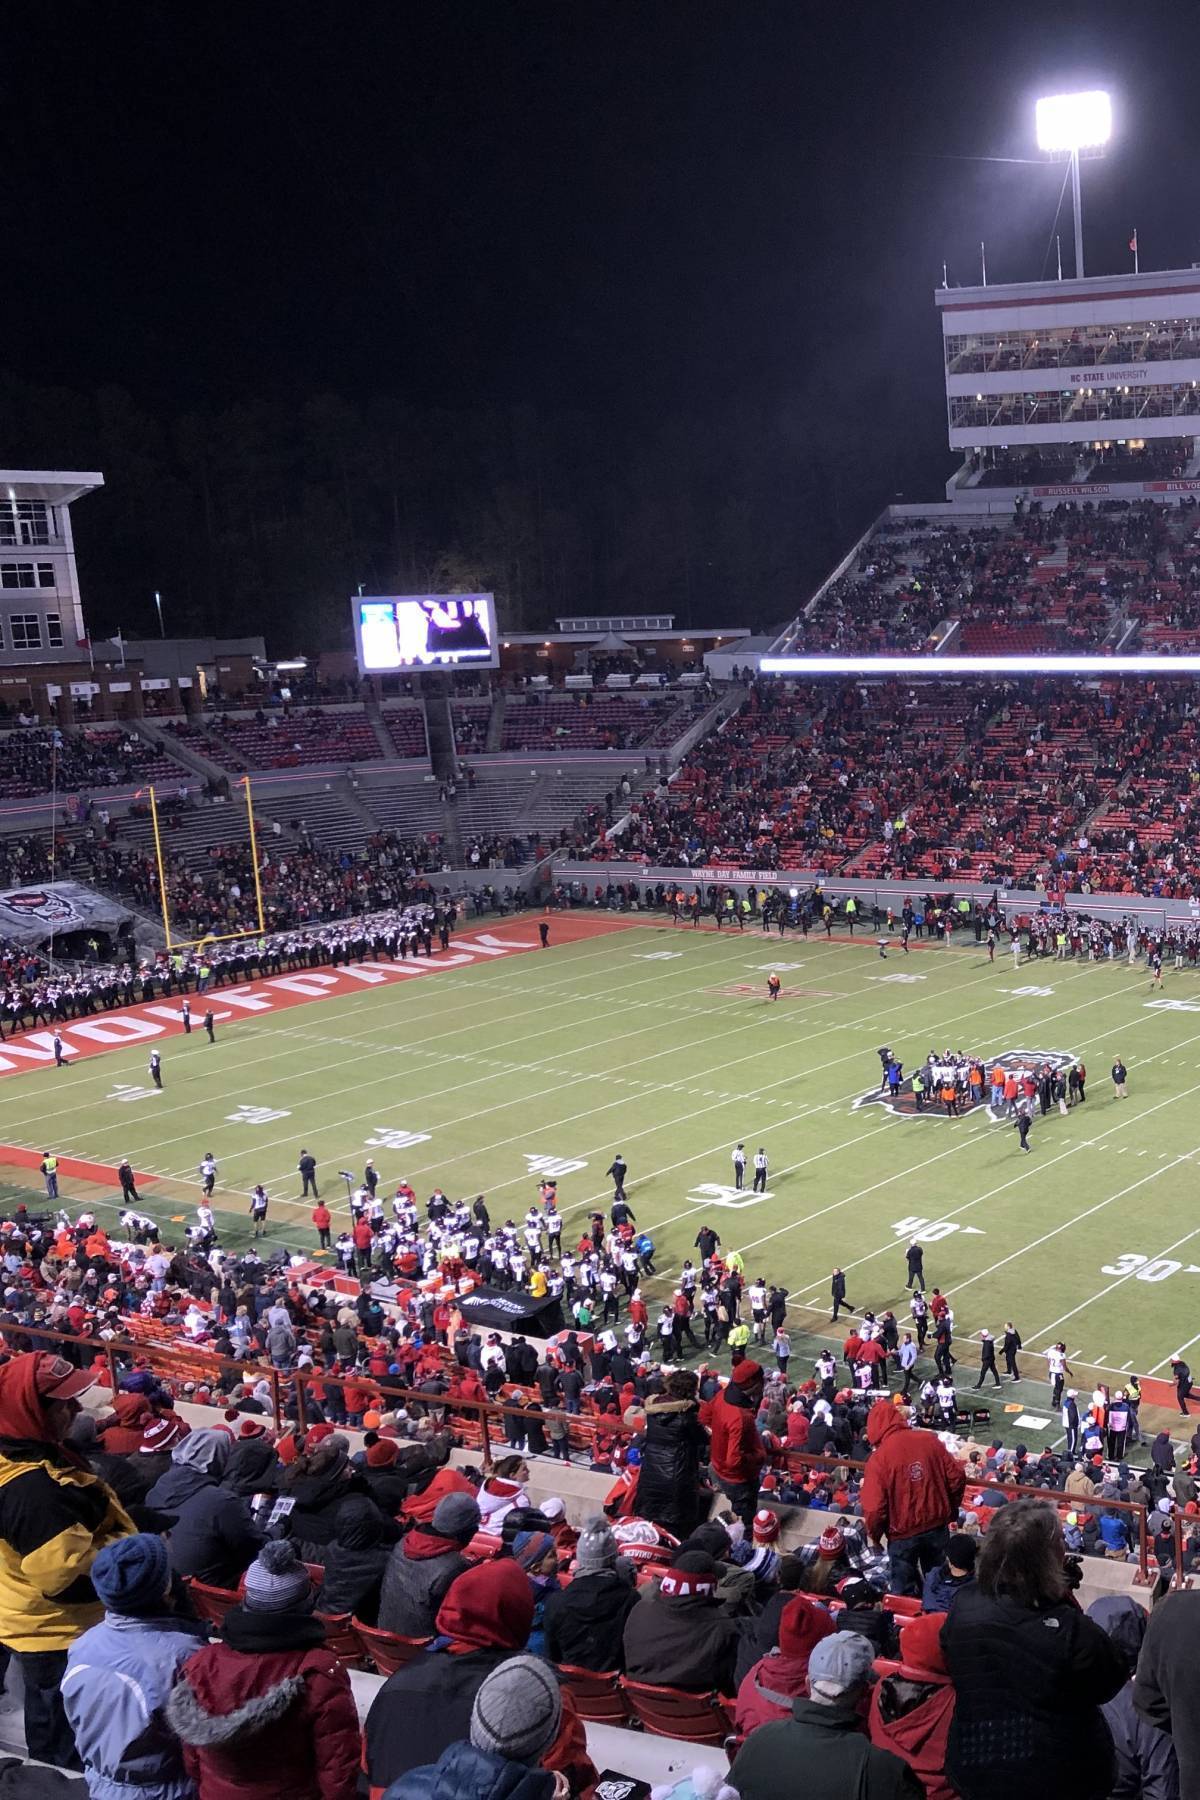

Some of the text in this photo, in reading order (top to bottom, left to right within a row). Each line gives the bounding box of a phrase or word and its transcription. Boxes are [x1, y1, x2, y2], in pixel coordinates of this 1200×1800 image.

[1070, 369, 1148, 383] NC STATE UNIVERSITY
[1048, 486, 1109, 495] RUSSELL WILSON
[1166, 482, 1183, 490] BILL
[691, 869, 778, 880] WAYNE DAY FAMILY FIELD
[224, 1107, 293, 1125] 20
[364, 1130, 433, 1149] 30
[527, 1155, 589, 1177] 40
[686, 1183, 776, 1209] 50
[891, 1216, 960, 1242] 40
[1101, 1253, 1183, 1282] 30
